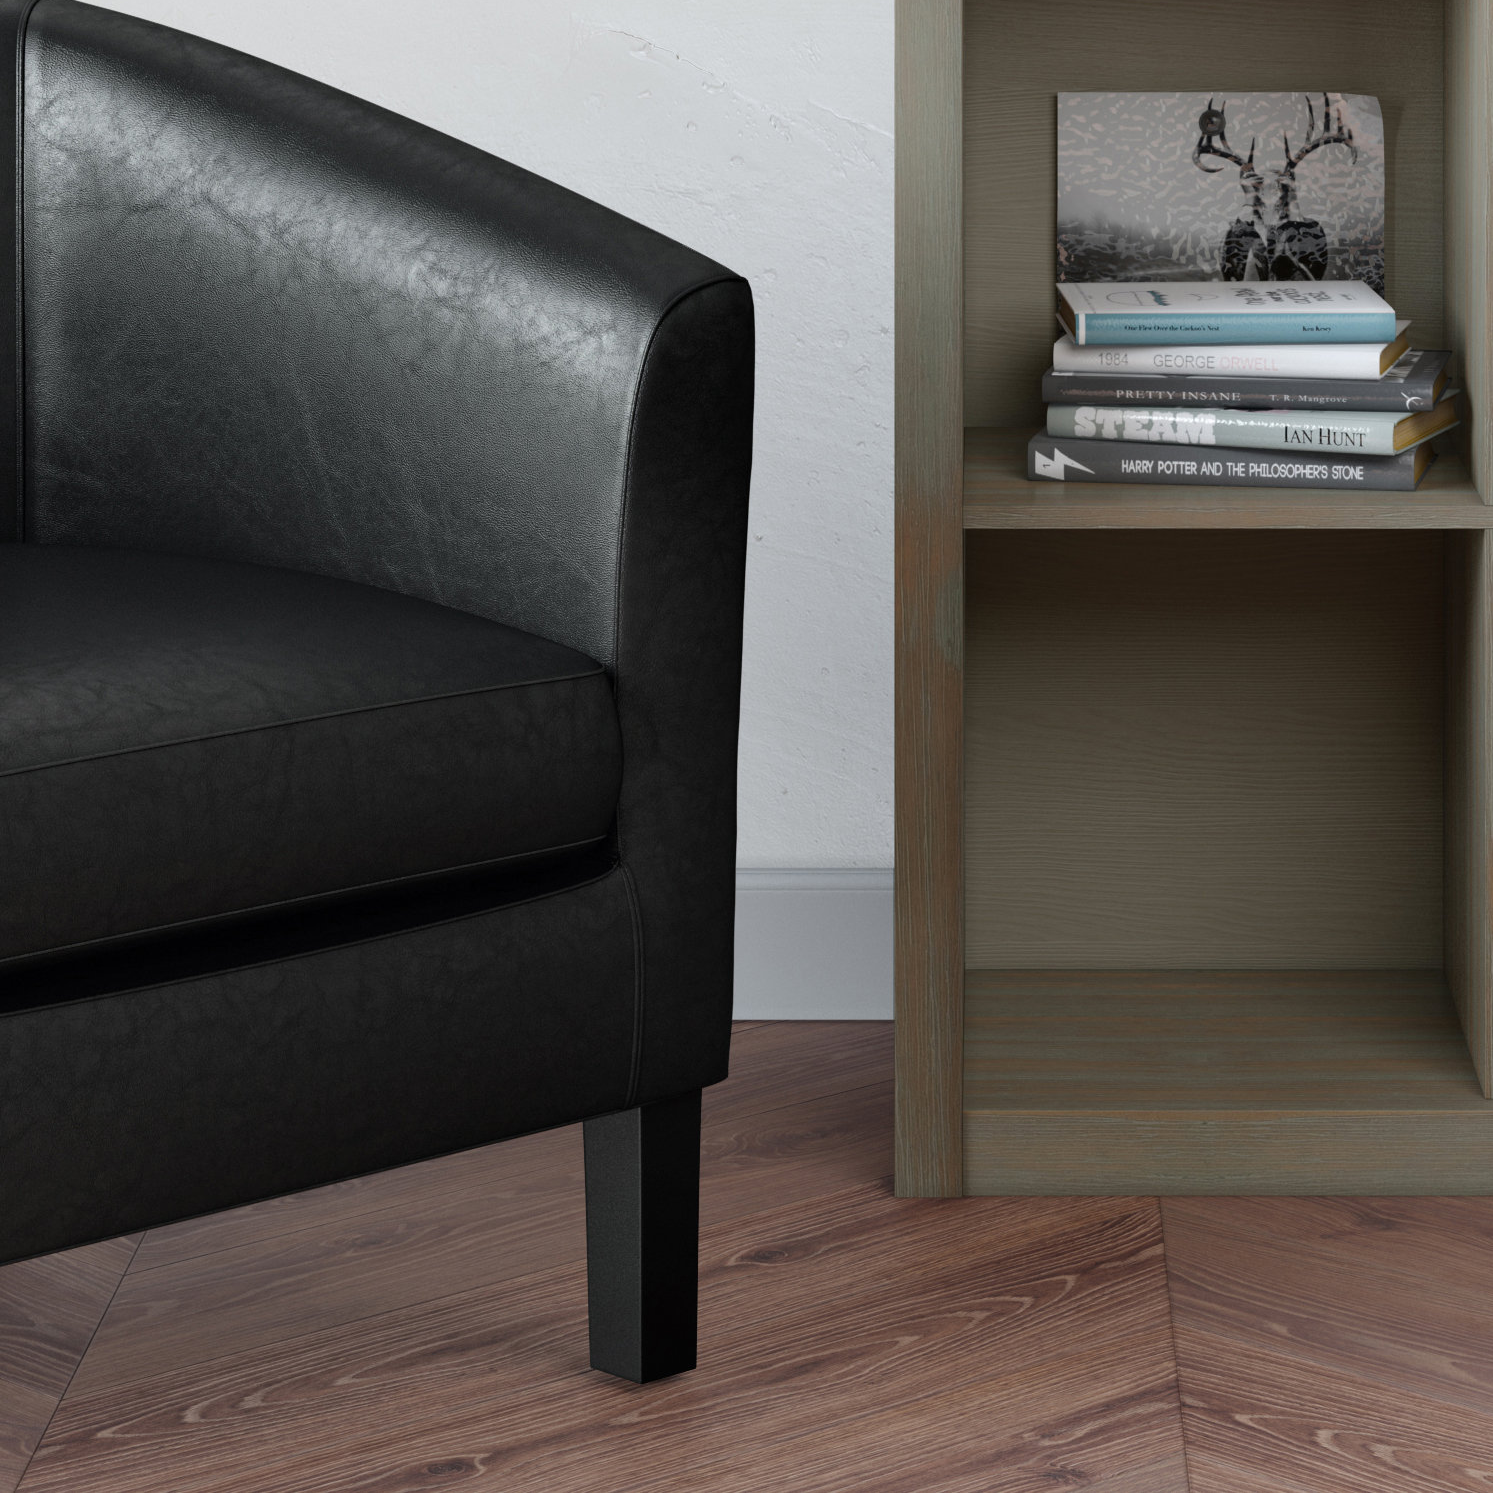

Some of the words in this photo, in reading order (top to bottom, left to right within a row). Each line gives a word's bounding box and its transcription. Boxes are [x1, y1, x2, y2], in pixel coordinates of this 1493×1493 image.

[1098, 352, 1129, 366] 1984
[1153, 354, 1215, 369] GEORGE
[1219, 356, 1279, 372] ORWELL
[1116, 389, 1176, 400] PRETTY
[1182, 391, 1241, 401] INSANE
[1298, 394, 1348, 404] Mangrove
[1074, 406, 1216, 445] STEAM
[1121, 459, 1154, 474] HARRY
[1158, 460, 1198, 475] POTTER
[1200, 461, 1223, 476] AND
[1226, 462, 1246, 477] THE
[1249, 463, 1328, 479] PHILOSOPHER'S
[1332, 465, 1364, 480] STONE
